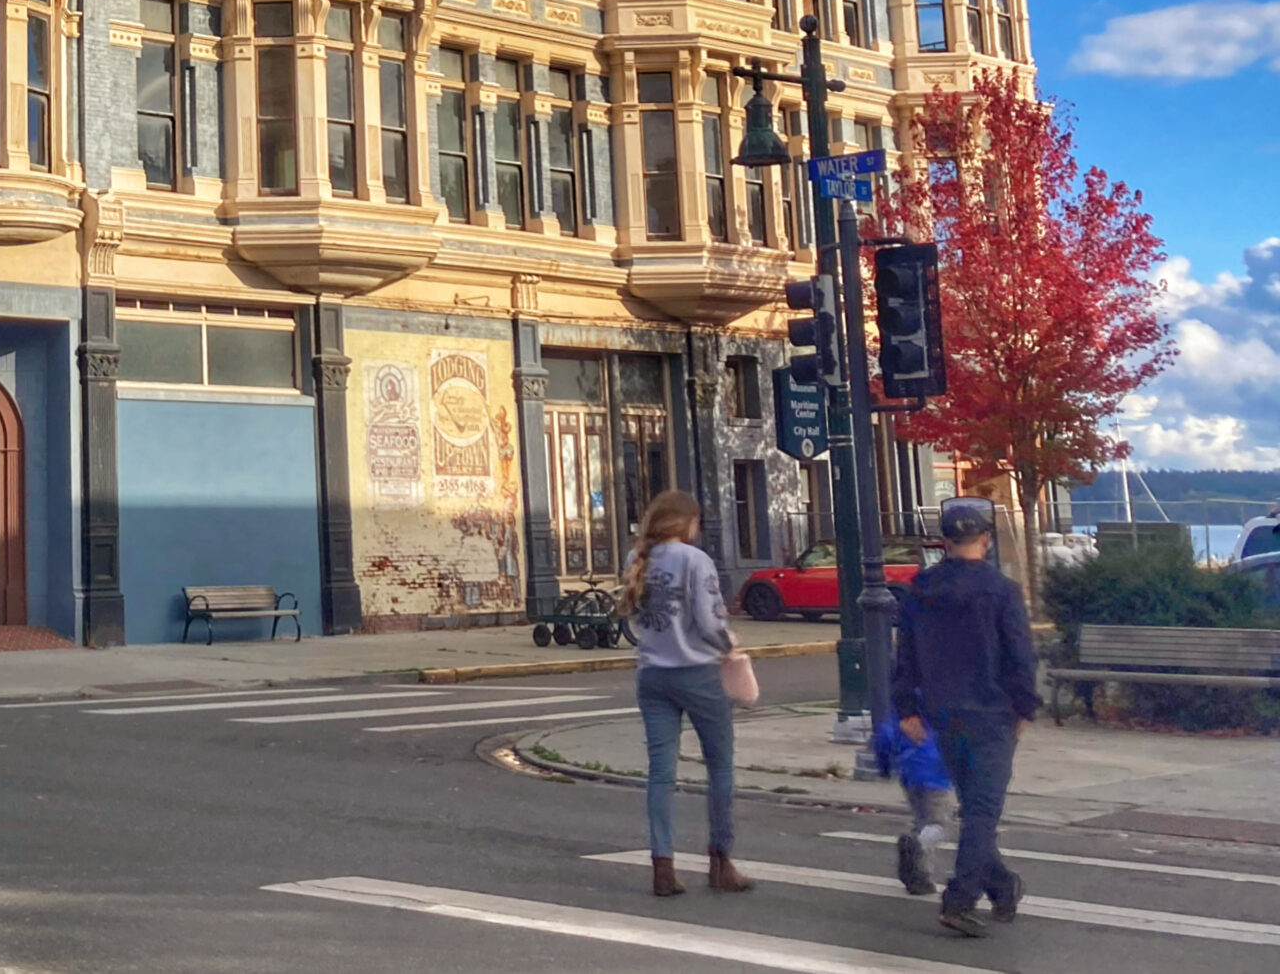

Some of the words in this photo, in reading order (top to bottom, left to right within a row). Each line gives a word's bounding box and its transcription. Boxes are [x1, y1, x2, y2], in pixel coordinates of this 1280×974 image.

[816, 156, 859, 176] WATER
[866, 156, 875, 166] ST
[826, 179, 857, 198] TAYLOR
[433, 357, 485, 390] LODGING
[790, 400, 819, 410] Maritime
[795, 409, 816, 418] Center
[793, 426, 806, 437] City
[807, 426, 820, 435] Hall
[370, 435, 417, 449] SEAFOOD
[435, 428, 489, 466] UPTOWN
